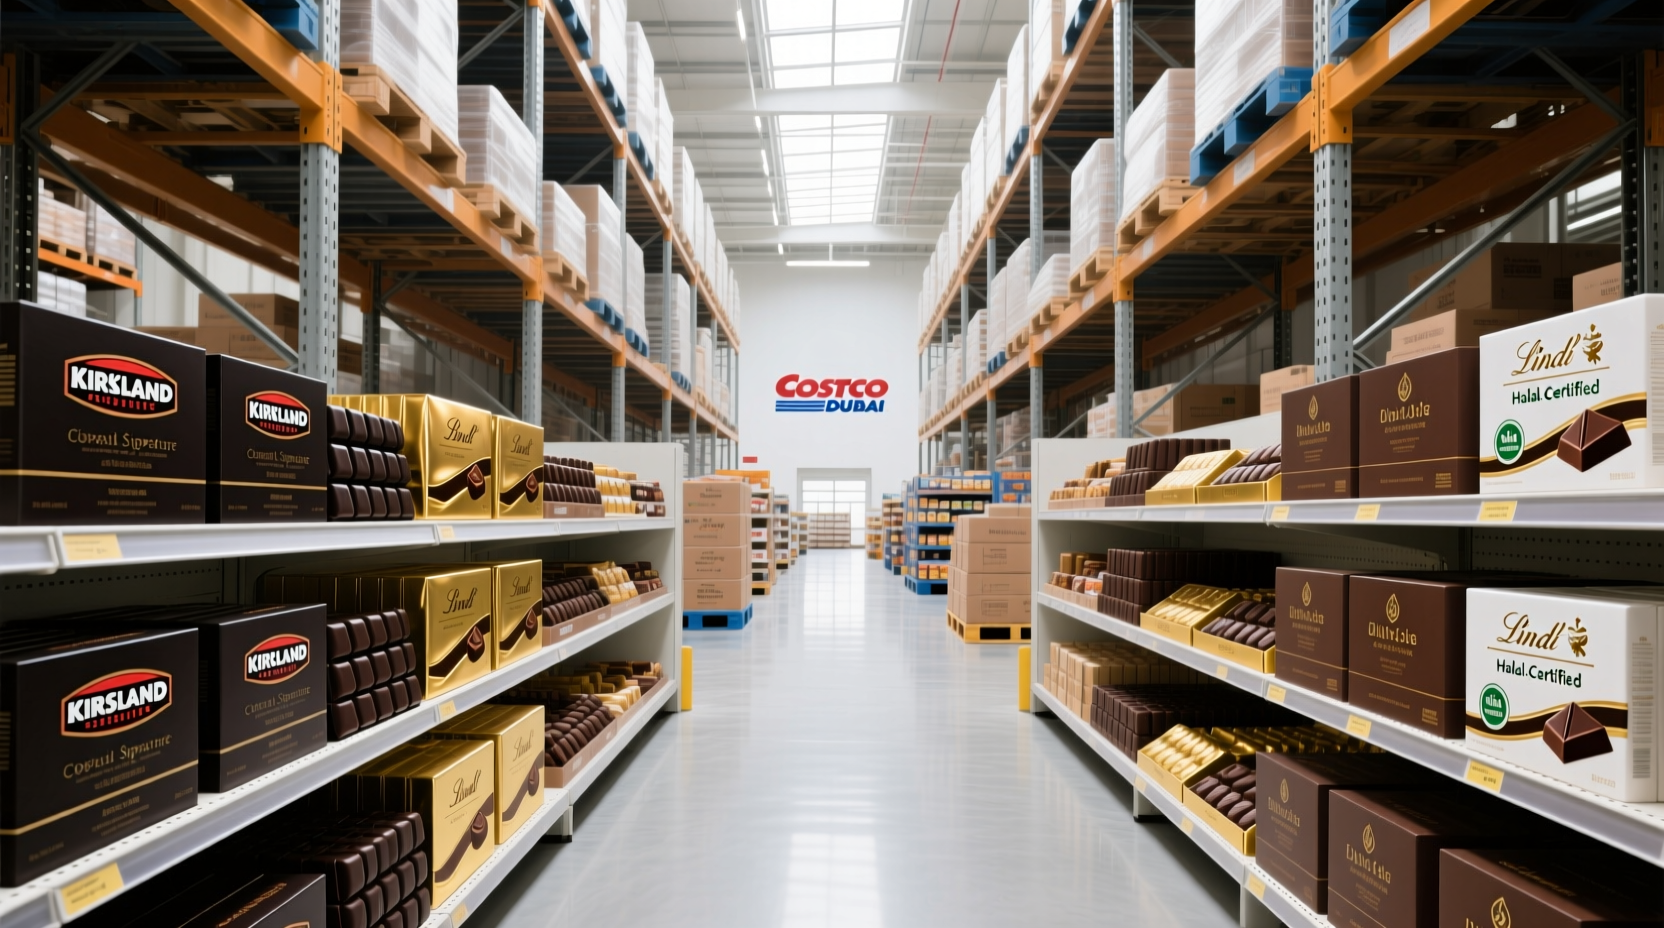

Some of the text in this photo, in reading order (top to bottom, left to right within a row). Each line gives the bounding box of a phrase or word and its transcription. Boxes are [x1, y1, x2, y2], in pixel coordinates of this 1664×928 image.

[775, 373, 889, 398] COSTCO
[1544, 379, 1600, 400] Certified
[825, 399, 885, 413] DUBAI
[1529, 665, 1582, 688] Certified
